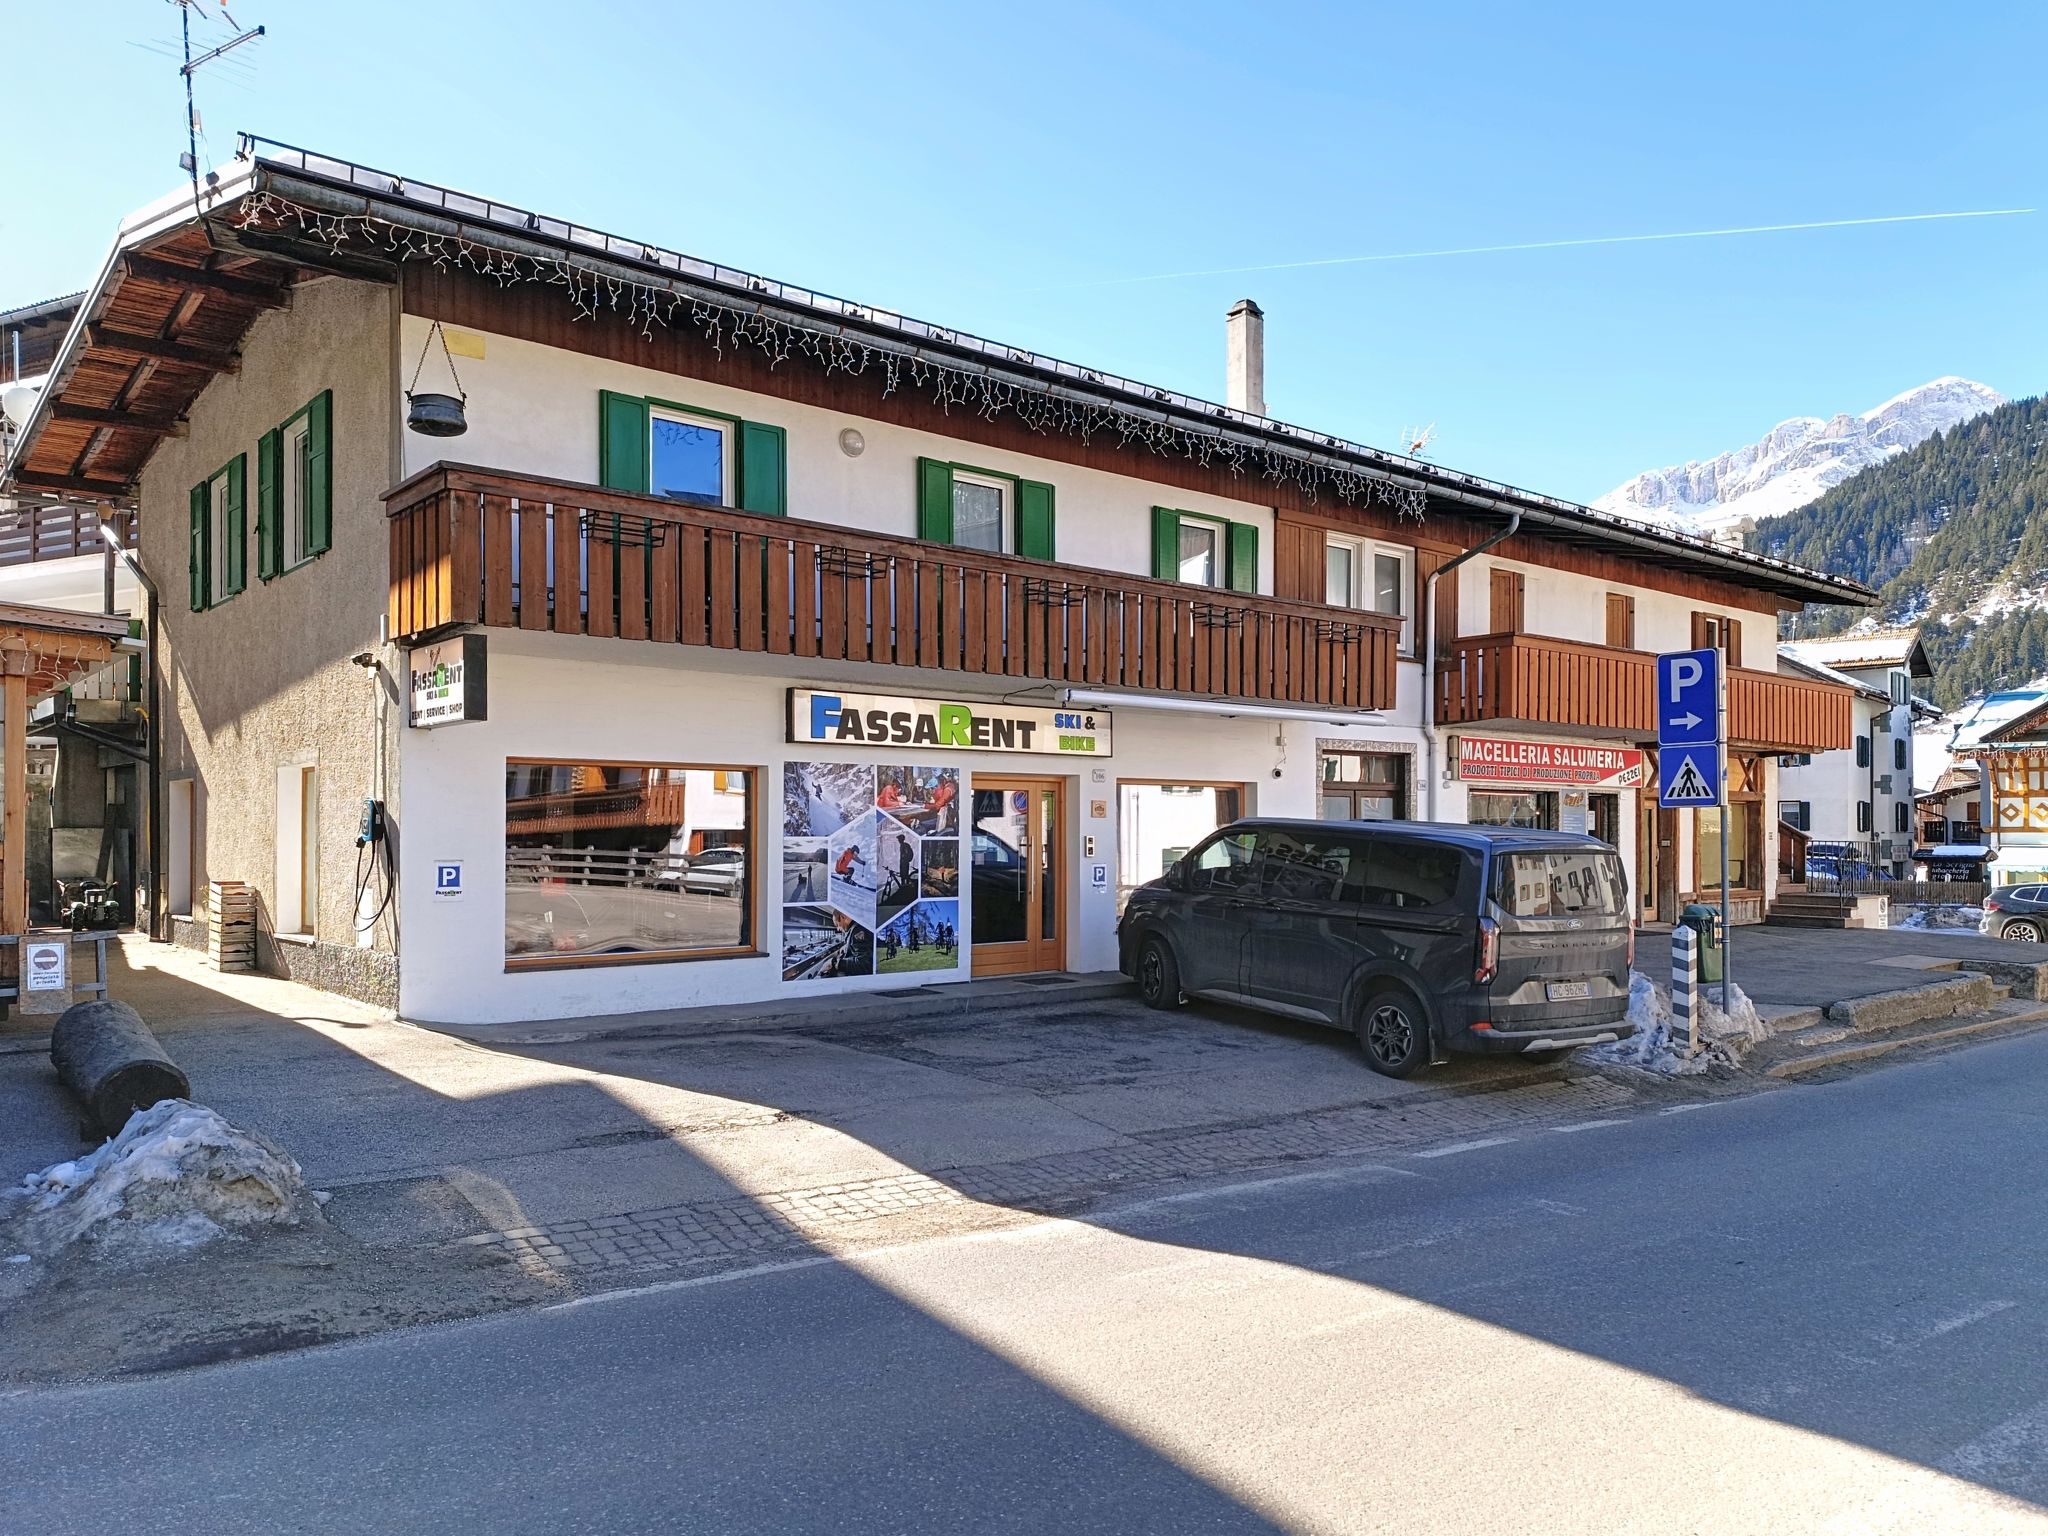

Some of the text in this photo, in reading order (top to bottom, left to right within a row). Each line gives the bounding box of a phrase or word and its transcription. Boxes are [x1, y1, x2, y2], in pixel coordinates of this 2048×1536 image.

[1670, 657, 1703, 703] P
[427, 706, 445, 717] SERVICE
[449, 703, 462, 713] SHOP
[810, 694, 1037, 750] FASSARENT
[1054, 712, 1097, 731] SKI &
[1058, 735, 1096, 752] BIKE
[1462, 740, 1625, 769] MACELLERIA SALUMERIA
[1462, 764, 1601, 781] PRODOTTI TIPICI DI PRODUZIONE PROPRIA
[1618, 767, 1641, 785] PEZZEI
[443, 868, 456, 885] P
[1096, 868, 1104, 880] P
